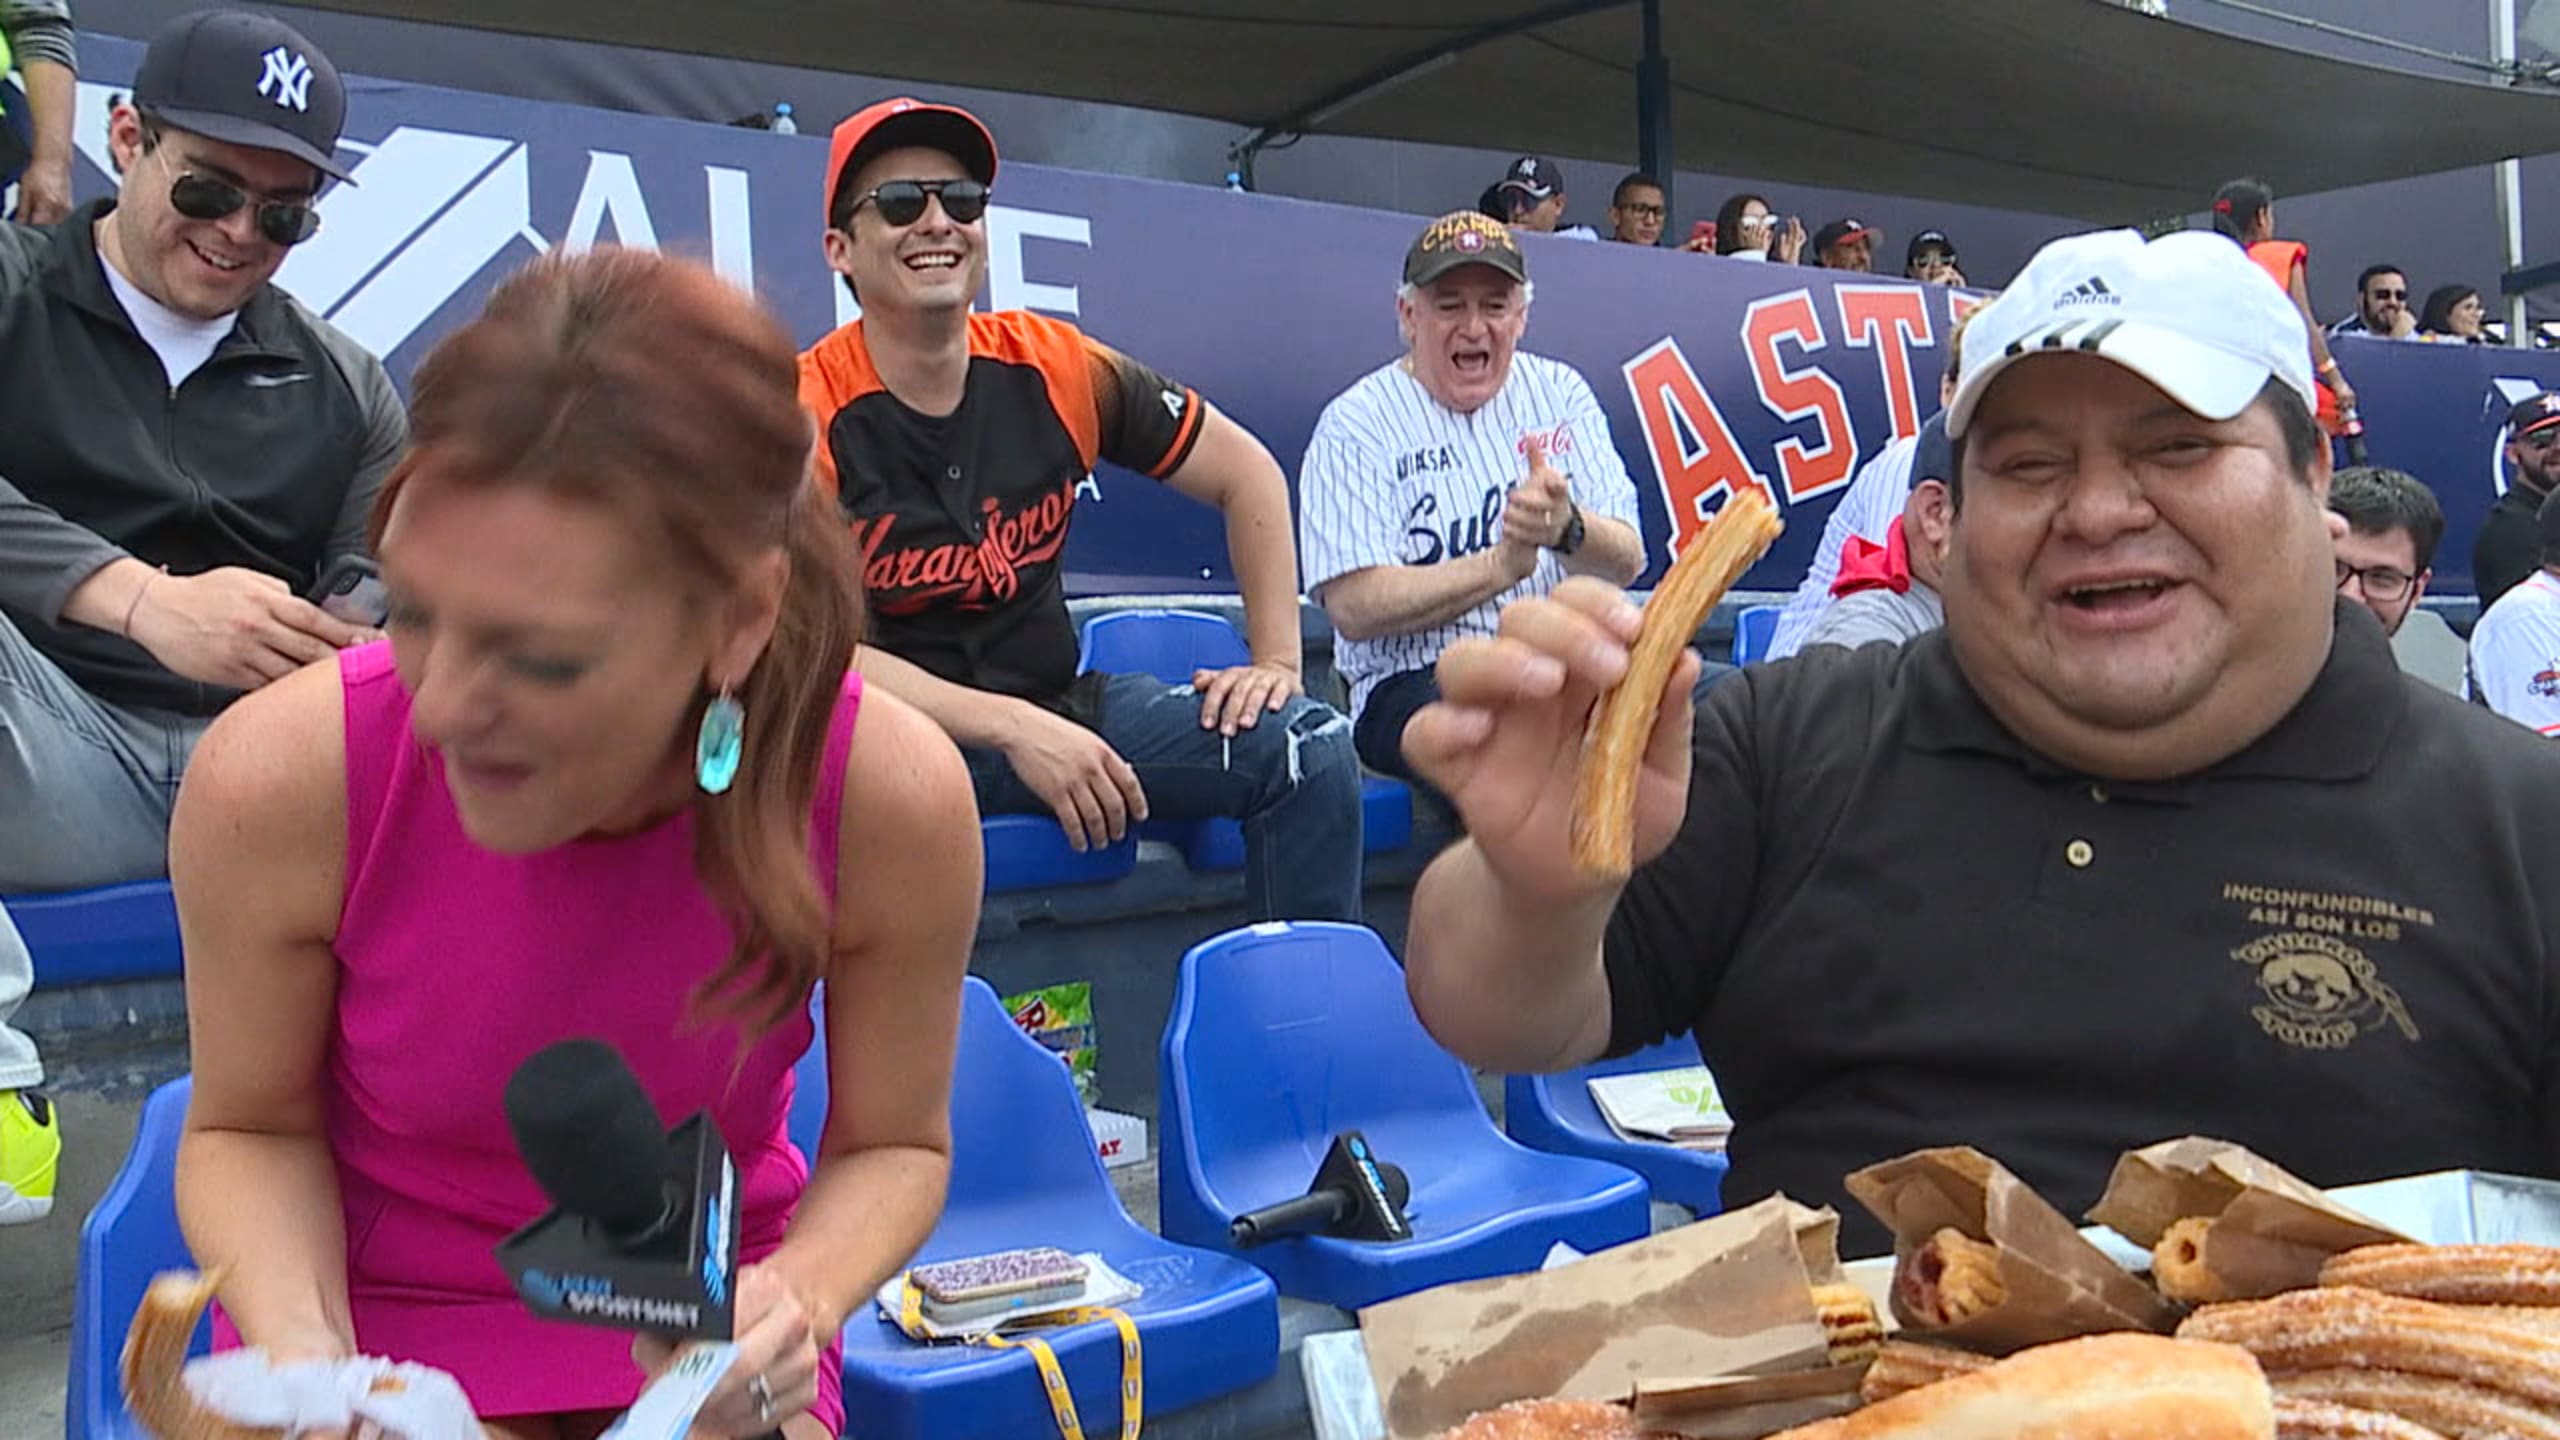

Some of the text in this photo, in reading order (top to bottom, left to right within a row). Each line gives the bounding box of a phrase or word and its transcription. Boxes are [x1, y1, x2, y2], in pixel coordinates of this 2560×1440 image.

[256, 46, 314, 112] NY
[1622, 283, 1998, 564] AST
[1402, 480, 1516, 566] Sul
[2223, 883, 2434, 926] INCONFUNDIBLES
[2294, 911, 2345, 933] SON
[2351, 919, 2400, 941] LOS
